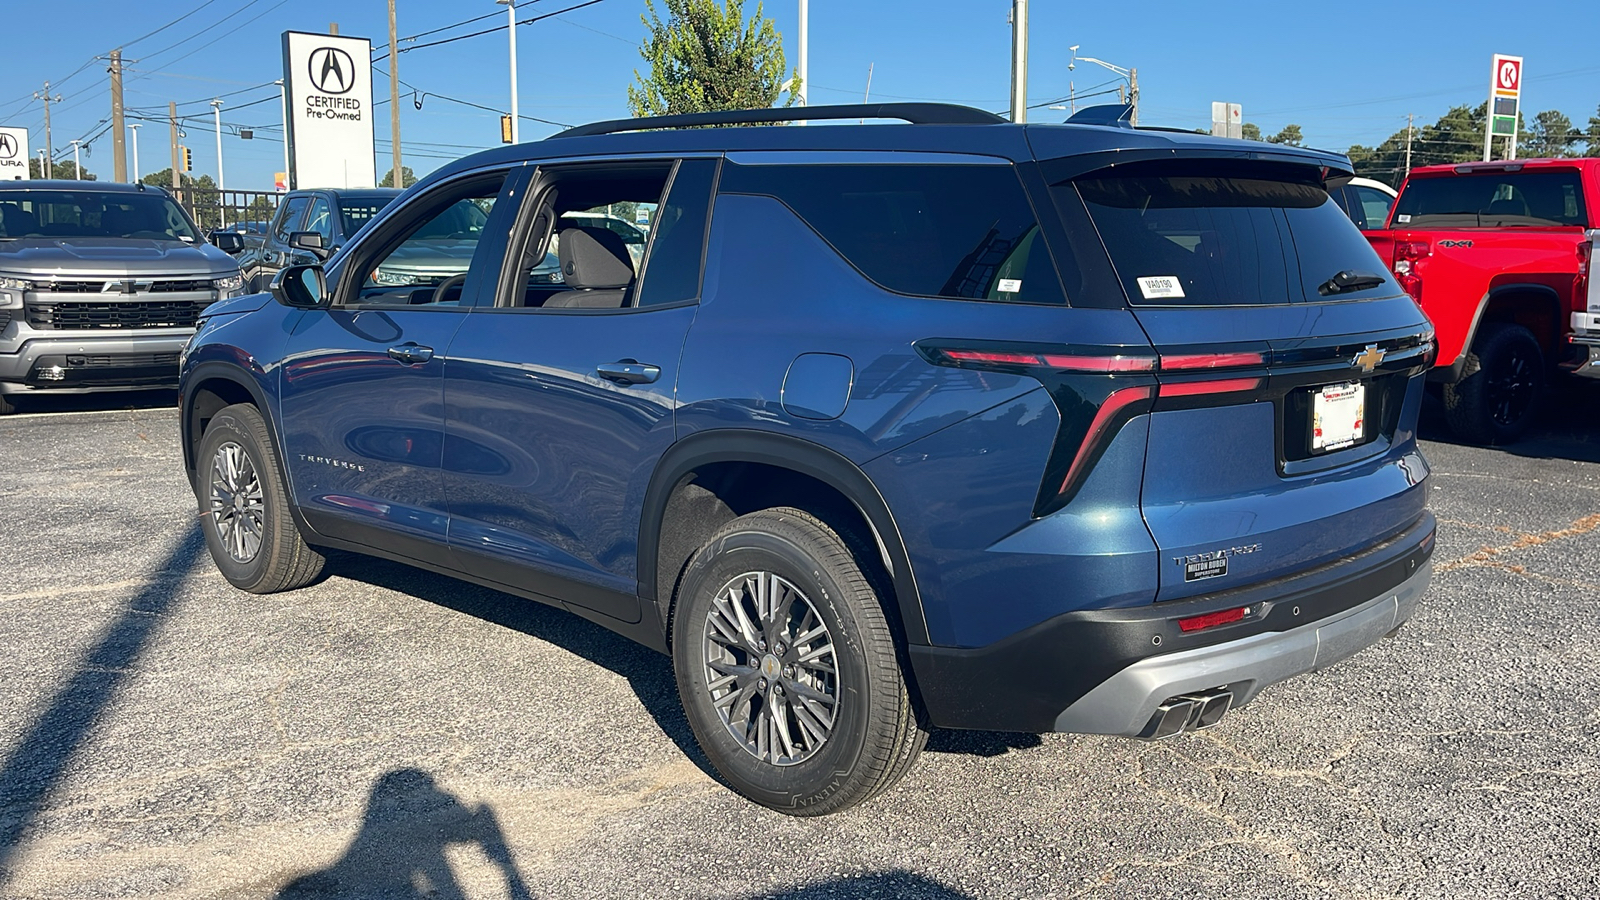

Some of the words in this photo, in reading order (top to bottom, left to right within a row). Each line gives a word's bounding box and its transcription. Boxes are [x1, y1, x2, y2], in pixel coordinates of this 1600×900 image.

[1504, 67, 1515, 86] K
[306, 95, 361, 110] CERTIFIED
[306, 107, 361, 121] Pre-Owned
[0, 159, 25, 168] URA
[299, 453, 365, 473] TRAVERSE
[1172, 542, 1263, 566] TRAVERSE
[1187, 561, 1208, 573] MILTON
[1208, 558, 1226, 570] RUBEN
[799, 778, 840, 807] ALENZA
